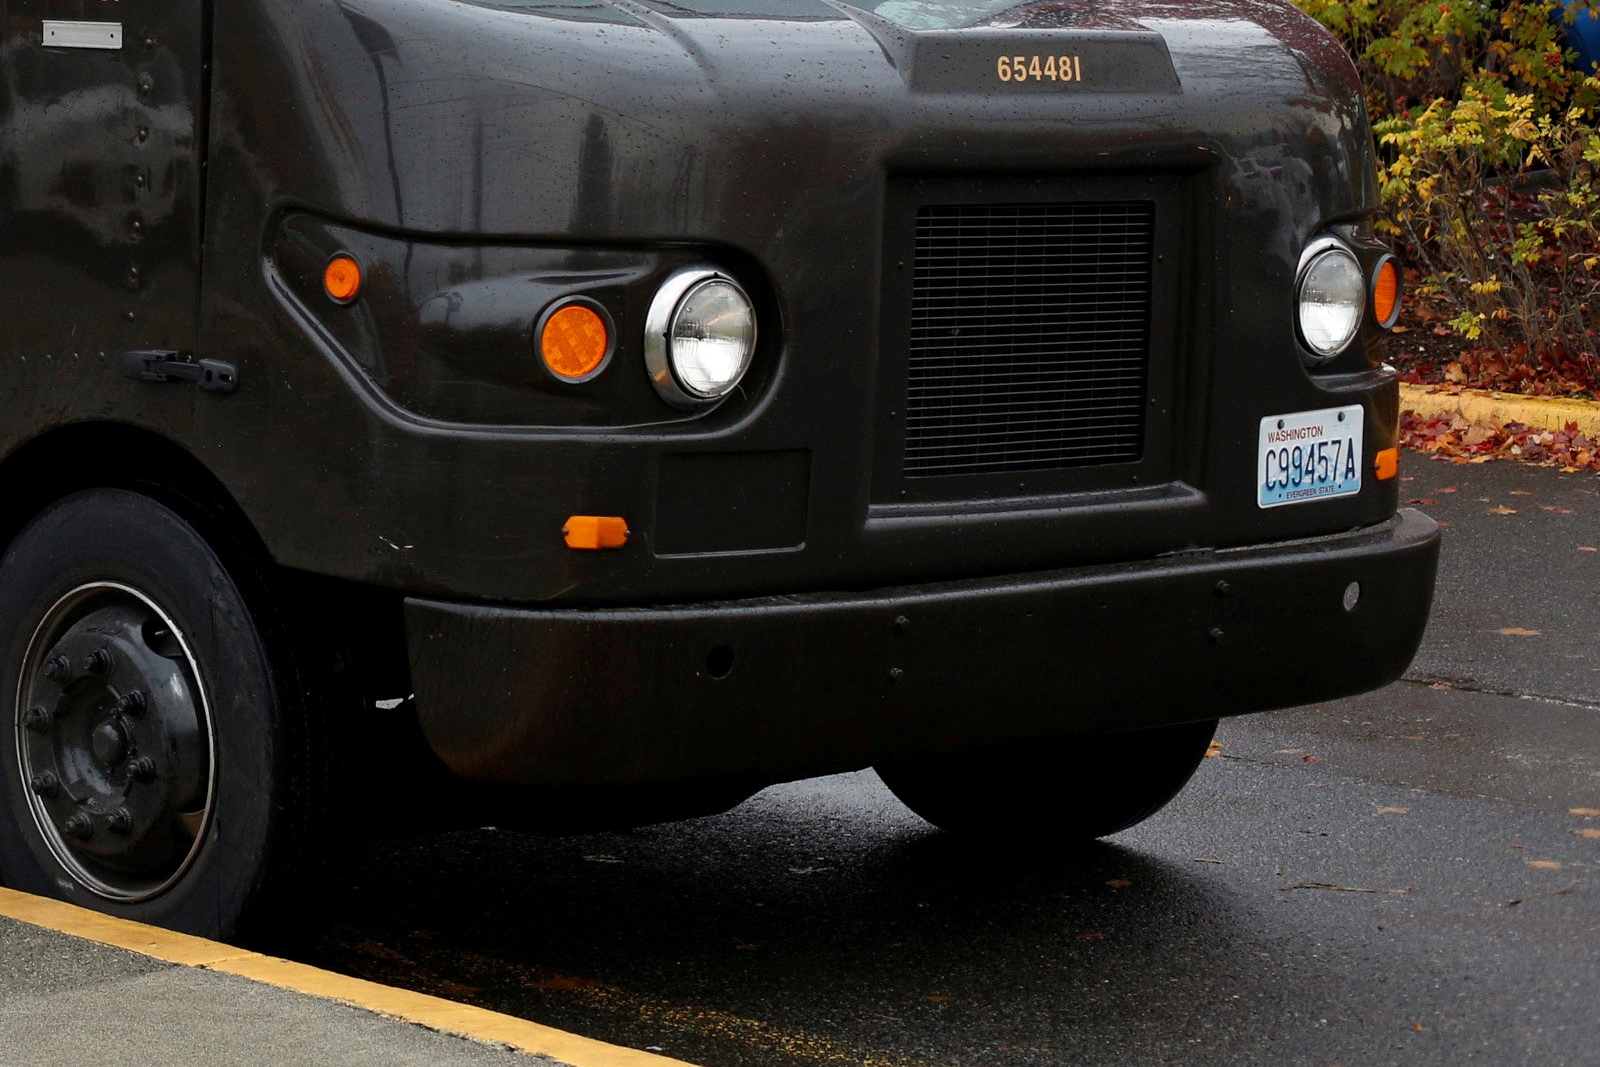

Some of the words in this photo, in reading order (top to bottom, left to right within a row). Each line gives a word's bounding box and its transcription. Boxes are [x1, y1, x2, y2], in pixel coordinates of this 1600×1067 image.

[997, 55, 1082, 82] 654481
[1267, 425, 1324, 444] WASHINGTON
[1265, 437, 1356, 492] C99457A
[1286, 487, 1317, 499] EVERGREEN
[1318, 484, 1335, 494] STATE
